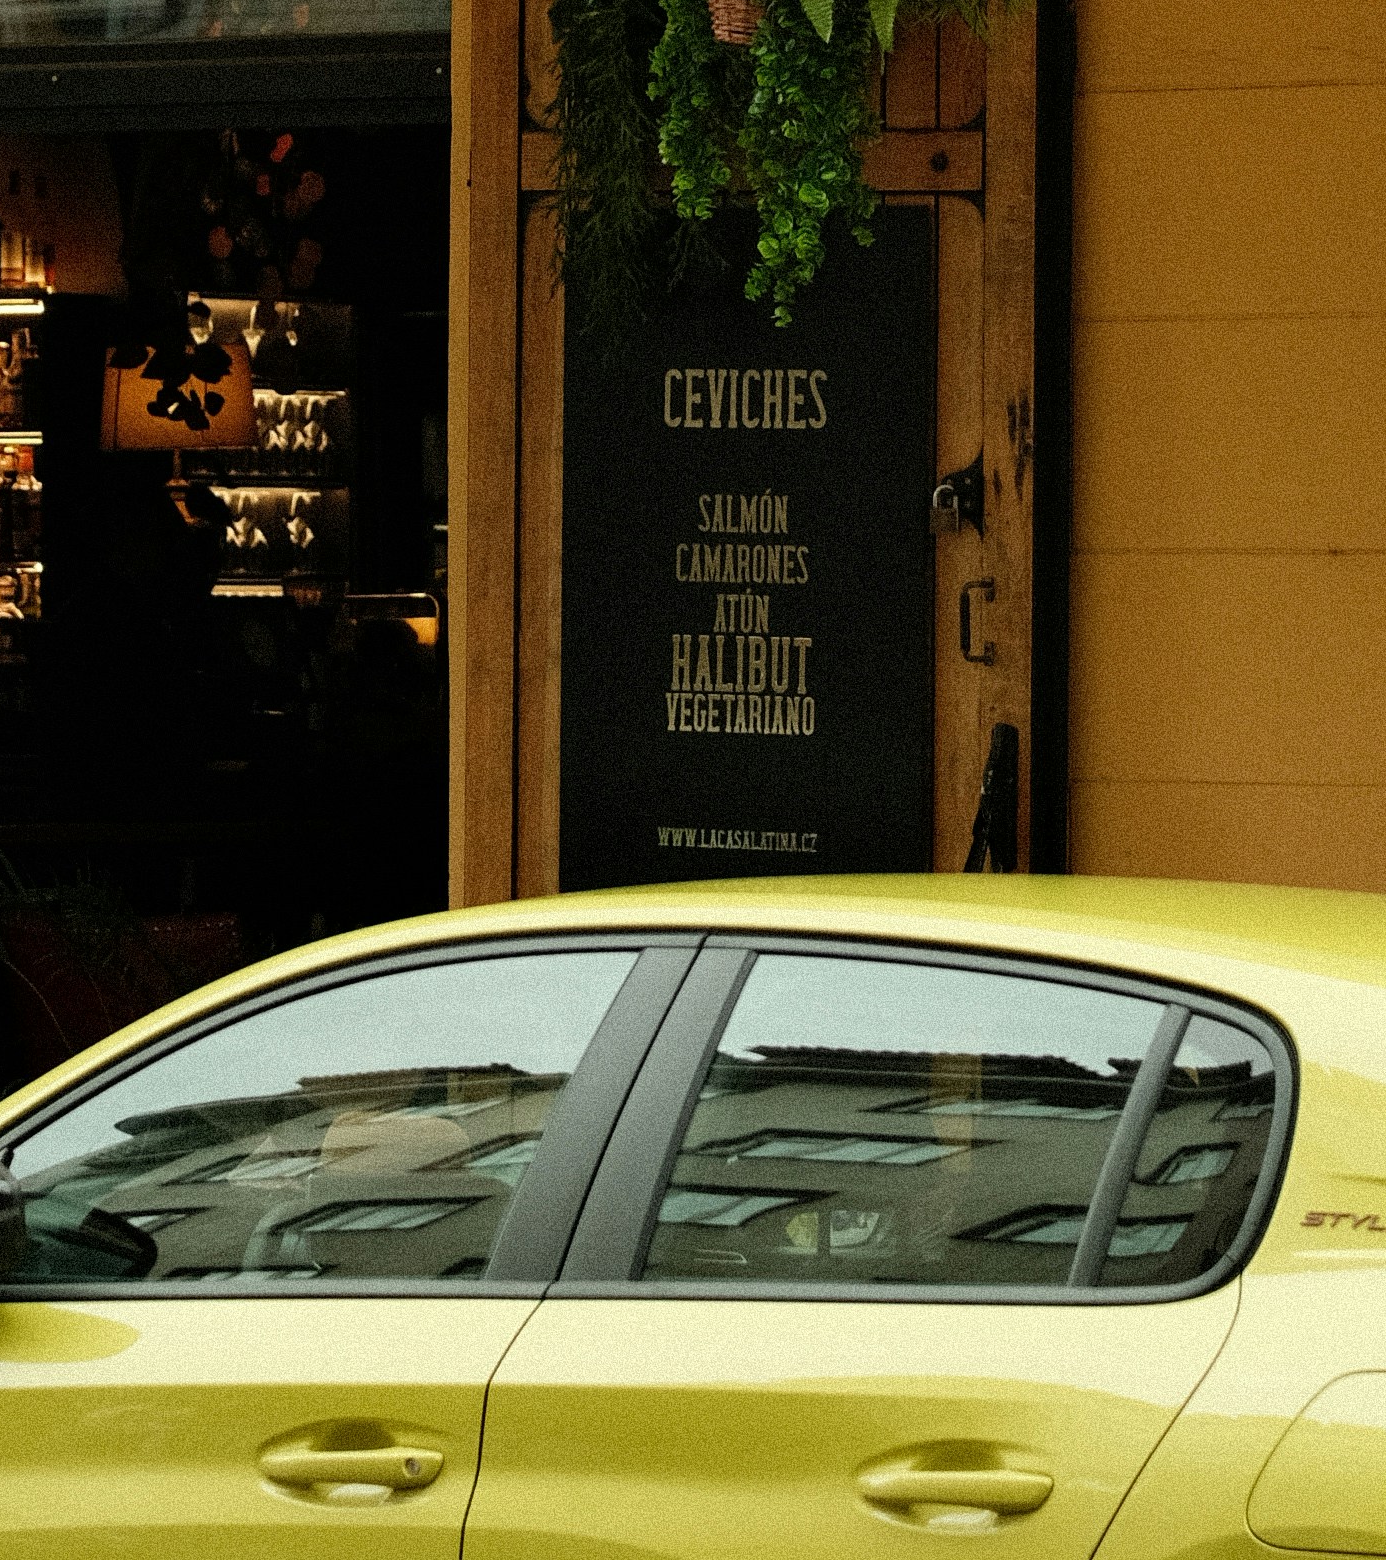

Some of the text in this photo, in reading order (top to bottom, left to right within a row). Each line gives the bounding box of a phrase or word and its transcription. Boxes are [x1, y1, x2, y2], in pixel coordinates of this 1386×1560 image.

[663, 368, 828, 429] CEVICHES
[697, 487, 789, 534] SALMÓN
[675, 542, 810, 585] CAMARONES
[713, 588, 770, 633] ATÚN
[670, 634, 812, 695] HALIBUT
[665, 692, 815, 736] VEGETARIANO
[657, 826, 818, 853] WWW.LACASALATINA.CZ
